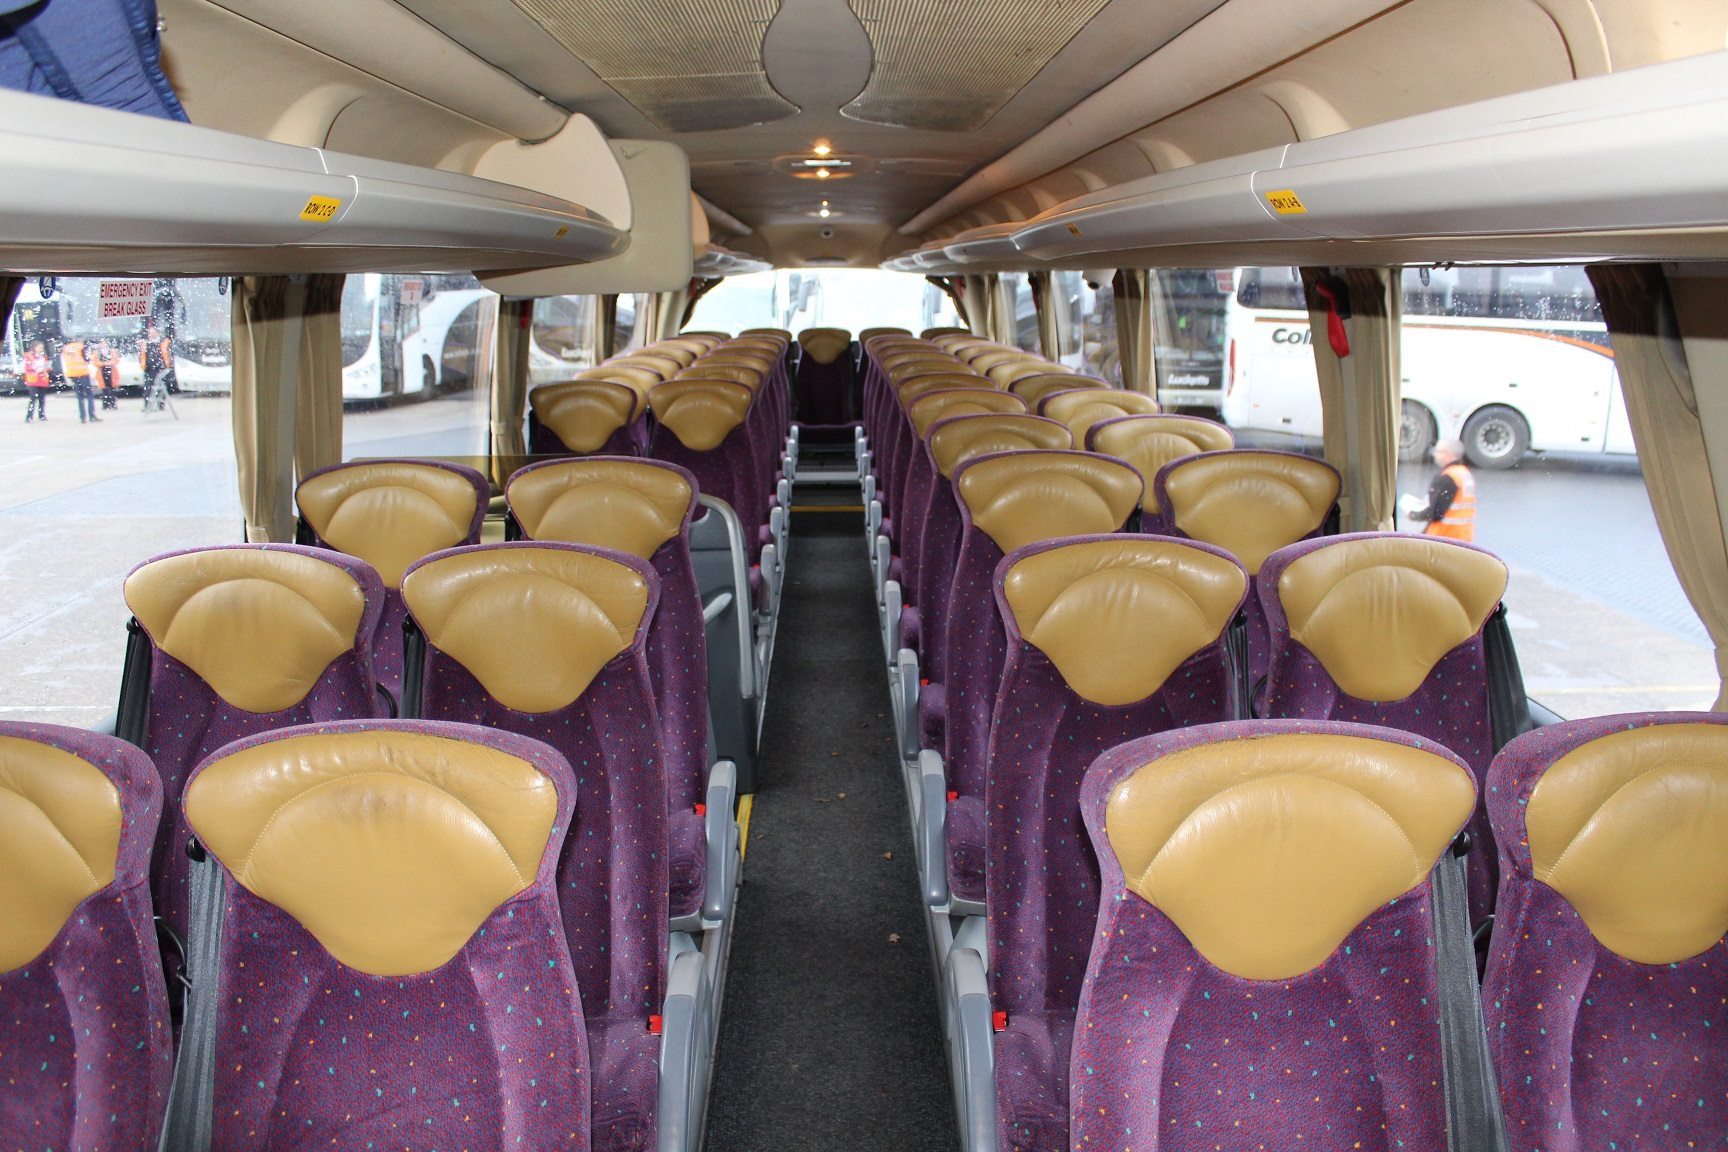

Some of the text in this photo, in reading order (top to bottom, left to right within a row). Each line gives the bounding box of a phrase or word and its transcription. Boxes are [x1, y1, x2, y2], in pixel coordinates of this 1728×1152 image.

[303, 202, 321, 214] ROW
[101, 282, 152, 299] EMERGENCY EXIT
[104, 300, 146, 317] BREAK GLASS
